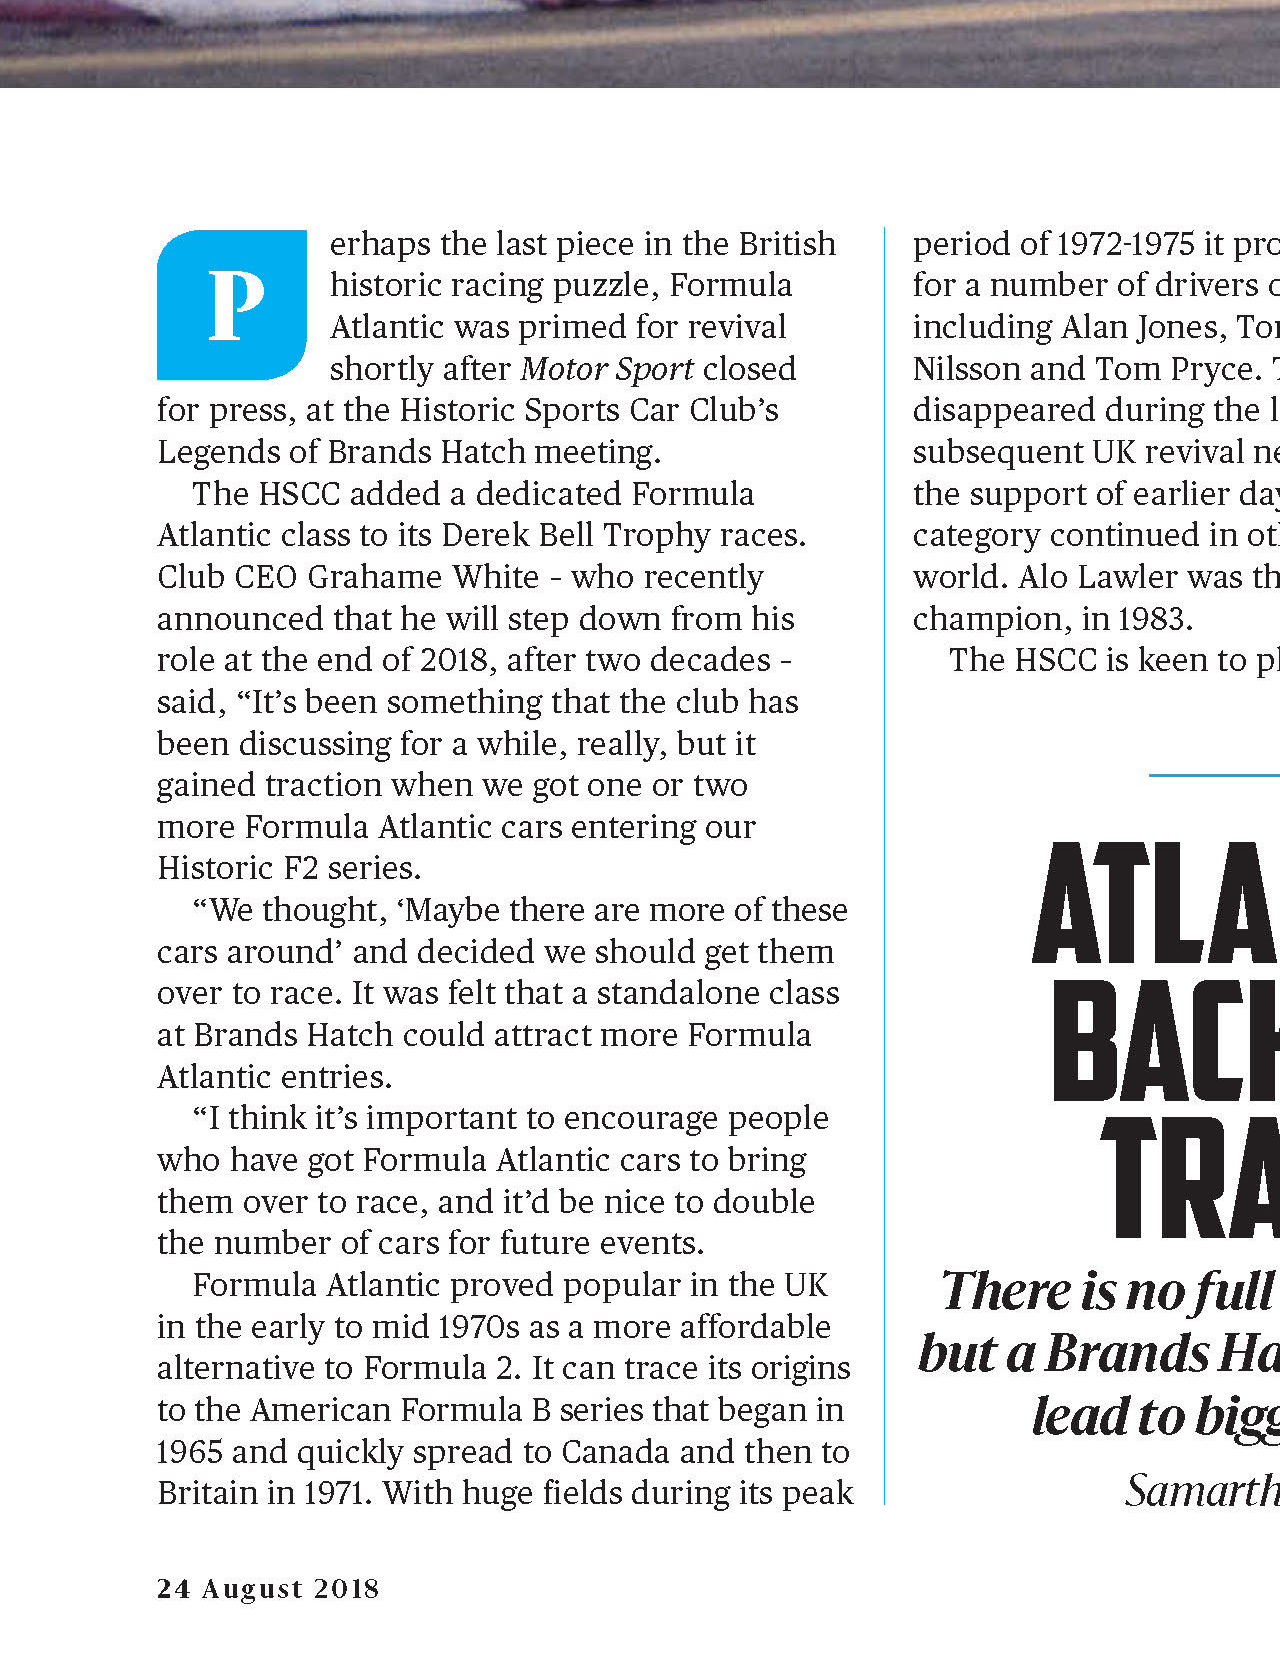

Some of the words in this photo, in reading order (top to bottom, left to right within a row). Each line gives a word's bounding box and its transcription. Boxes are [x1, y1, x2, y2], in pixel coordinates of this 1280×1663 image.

[331, 230, 430, 262] erhaps
[441, 230, 486, 255] the
[497, 230, 547, 255] last
[557, 231, 633, 262] piece
[645, 231, 672, 255] in
[683, 230, 728, 255] the
[740, 230, 836, 255] British
[914, 230, 1010, 262] period
[1021, 230, 1052, 255] of
[1059, 230, 1194, 255] 1972-1975
[1205, 231, 1224, 255] it
[331, 271, 441, 296] historic
[452, 272, 544, 303] racing
[554, 271, 658, 303] puzzle,
[671, 271, 792, 296] Formula
[914, 271, 956, 296] for
[966, 279, 980, 296] a
[991, 271, 1108, 296] number
[1118, 271, 1149, 296] of
[1156, 271, 1258, 296] drivers
[207, 270, 265, 341] P
[330, 313, 443, 338] Atlantic
[454, 321, 509, 338] was
[519, 313, 626, 345] primed
[637, 313, 678, 338] for
[689, 313, 786, 338] revival
[914, 313, 1053, 345] including
[1061, 313, 1128, 338] Alan
[1136, 315, 1226, 344] Jones,
[331, 355, 434, 387] shortly
[444, 355, 511, 380] after
[520, 357, 609, 380] Motor
[616, 357, 695, 387] Sport
[704, 355, 796, 380] closed
[914, 355, 1021, 380] Nilsson
[1031, 355, 1085, 380] and
[1096, 357, 1161, 380] Tom
[1172, 357, 1261, 387] Pryce.
[158, 396, 199, 421] for
[210, 404, 295, 428] press,
[307, 400, 334, 421] at
[344, 396, 389, 421] the
[401, 397, 514, 421] Historic
[526, 398, 619, 428] Sports
[631, 398, 679, 421] Car
[691, 396, 778, 421] Club’s
[159, 438, 280, 470] Legends
[290, 438, 321, 463] of
[329, 438, 431, 463] Brands
[442, 438, 526, 463] Hatch
[535, 439, 660, 470] meeting.
[914, 605, 1071, 637] champion,
[1083, 606, 1110, 630] in
[1120, 607, 1192, 630] 1983.
[950, 646, 1004, 671] The
[1016, 648, 1096, 671] HSCC
[1107, 647, 1128, 671] is
[1139, 646, 1208, 671] keen
[1218, 650, 1246, 671] to
[943, 1270, 1071, 1310] There
[1082, 1270, 1117, 1310] is
[1126, 1281, 1185, 1310] no
[1186, 1270, 1276, 1319] full
[918, 1332, 999, 1372] but
[1007, 1343, 1036, 1372] a
[1044, 1332, 1210, 1372] Brands
[1033, 1395, 1131, 1435] lead
[1139, 1400, 1185, 1435] to
[158, 1438, 222, 1463] 1965
[233, 1438, 287, 1463] and
[298, 1438, 404, 1470] quickly
[414, 1438, 512, 1470] spread
[524, 1442, 551, 1463] to
[563, 1438, 669, 1463] Canada
[681, 1438, 734, 1463] and
[745, 1438, 812, 1463] then
[822, 1442, 849, 1463] to
[159, 1480, 258, 1504] Britain
[268, 1480, 295, 1504] in
[306, 1481, 371, 1504] 1971.
[382, 1479, 453, 1504] With
[463, 1479, 532, 1511] huge
[544, 1479, 622, 1504] fields
[632, 1479, 731, 1511] during
[740, 1480, 772, 1504] its
[783, 1479, 854, 1511] peak
[158, 1579, 190, 1598] 24
[202, 1579, 302, 1604] August
[315, 1579, 378, 1598] 2018
